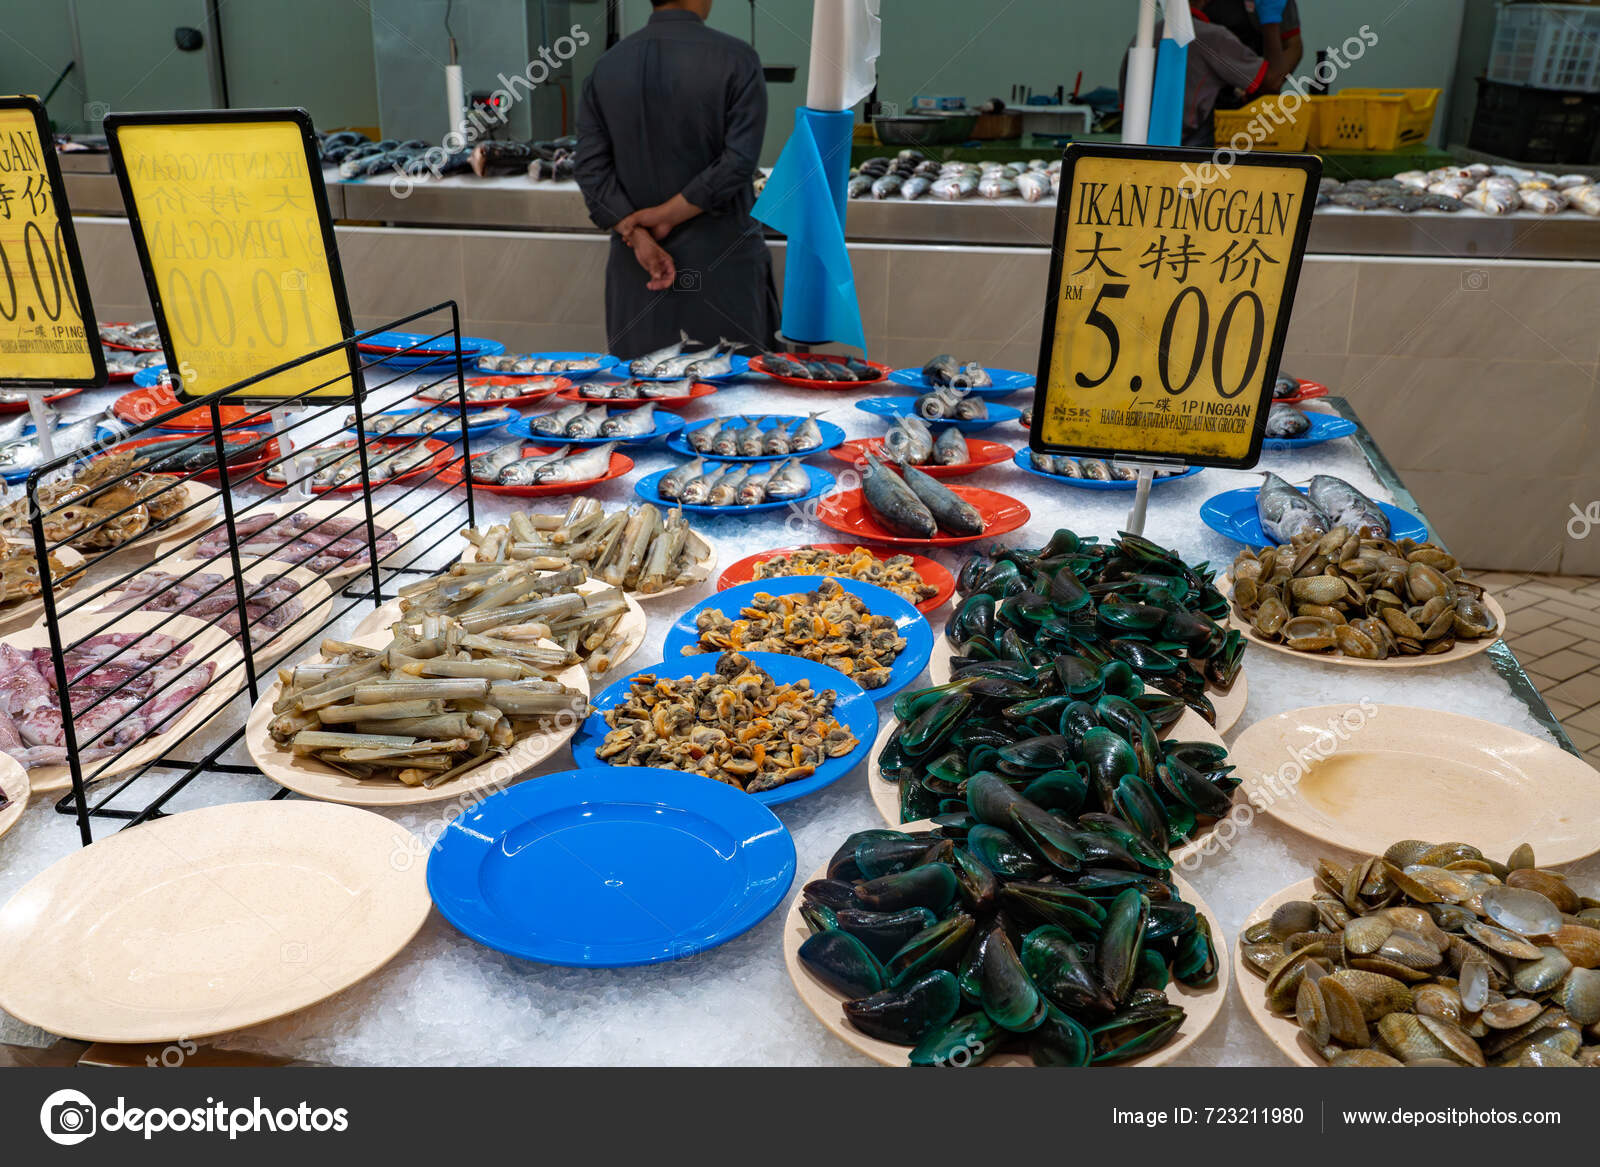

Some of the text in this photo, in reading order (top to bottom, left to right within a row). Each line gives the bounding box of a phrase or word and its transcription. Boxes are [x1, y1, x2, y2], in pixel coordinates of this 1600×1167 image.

[1075, 182, 1295, 236] IKAN PINGGAN
[1072, 231, 1280, 289] 大特价
[1065, 285, 1083, 301] RM
[52, 325, 86, 338] 1PING
[1074, 283, 1264, 399] 5.00
